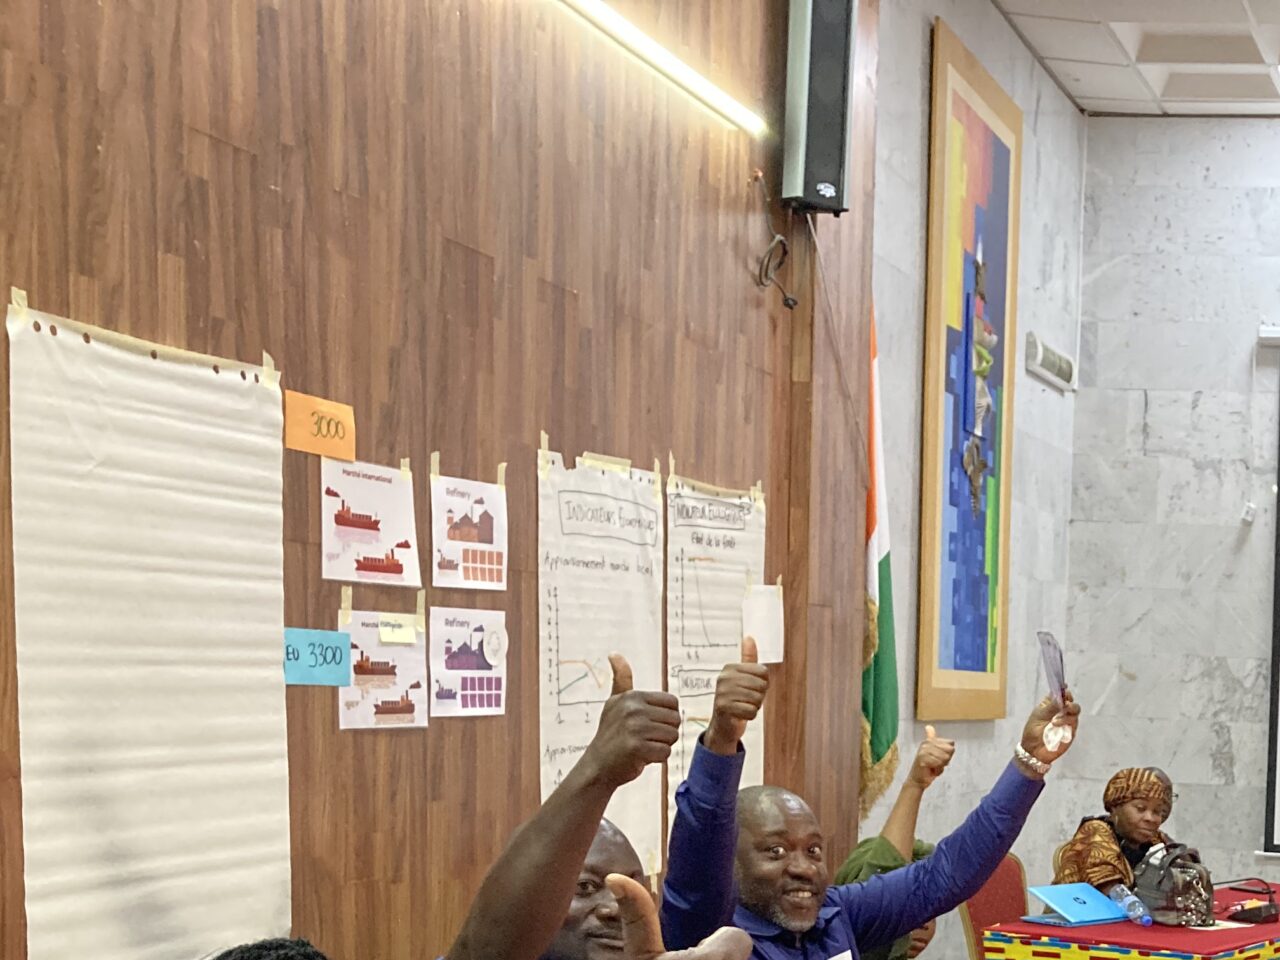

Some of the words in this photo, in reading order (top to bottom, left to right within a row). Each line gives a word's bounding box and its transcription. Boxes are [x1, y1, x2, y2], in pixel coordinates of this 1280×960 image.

[311, 410, 346, 440] 3000
[445, 487, 471, 499] Refinery
[445, 617, 470, 629] Refinery
[286, 646, 300, 662] EU
[308, 642, 343, 668] 3300
